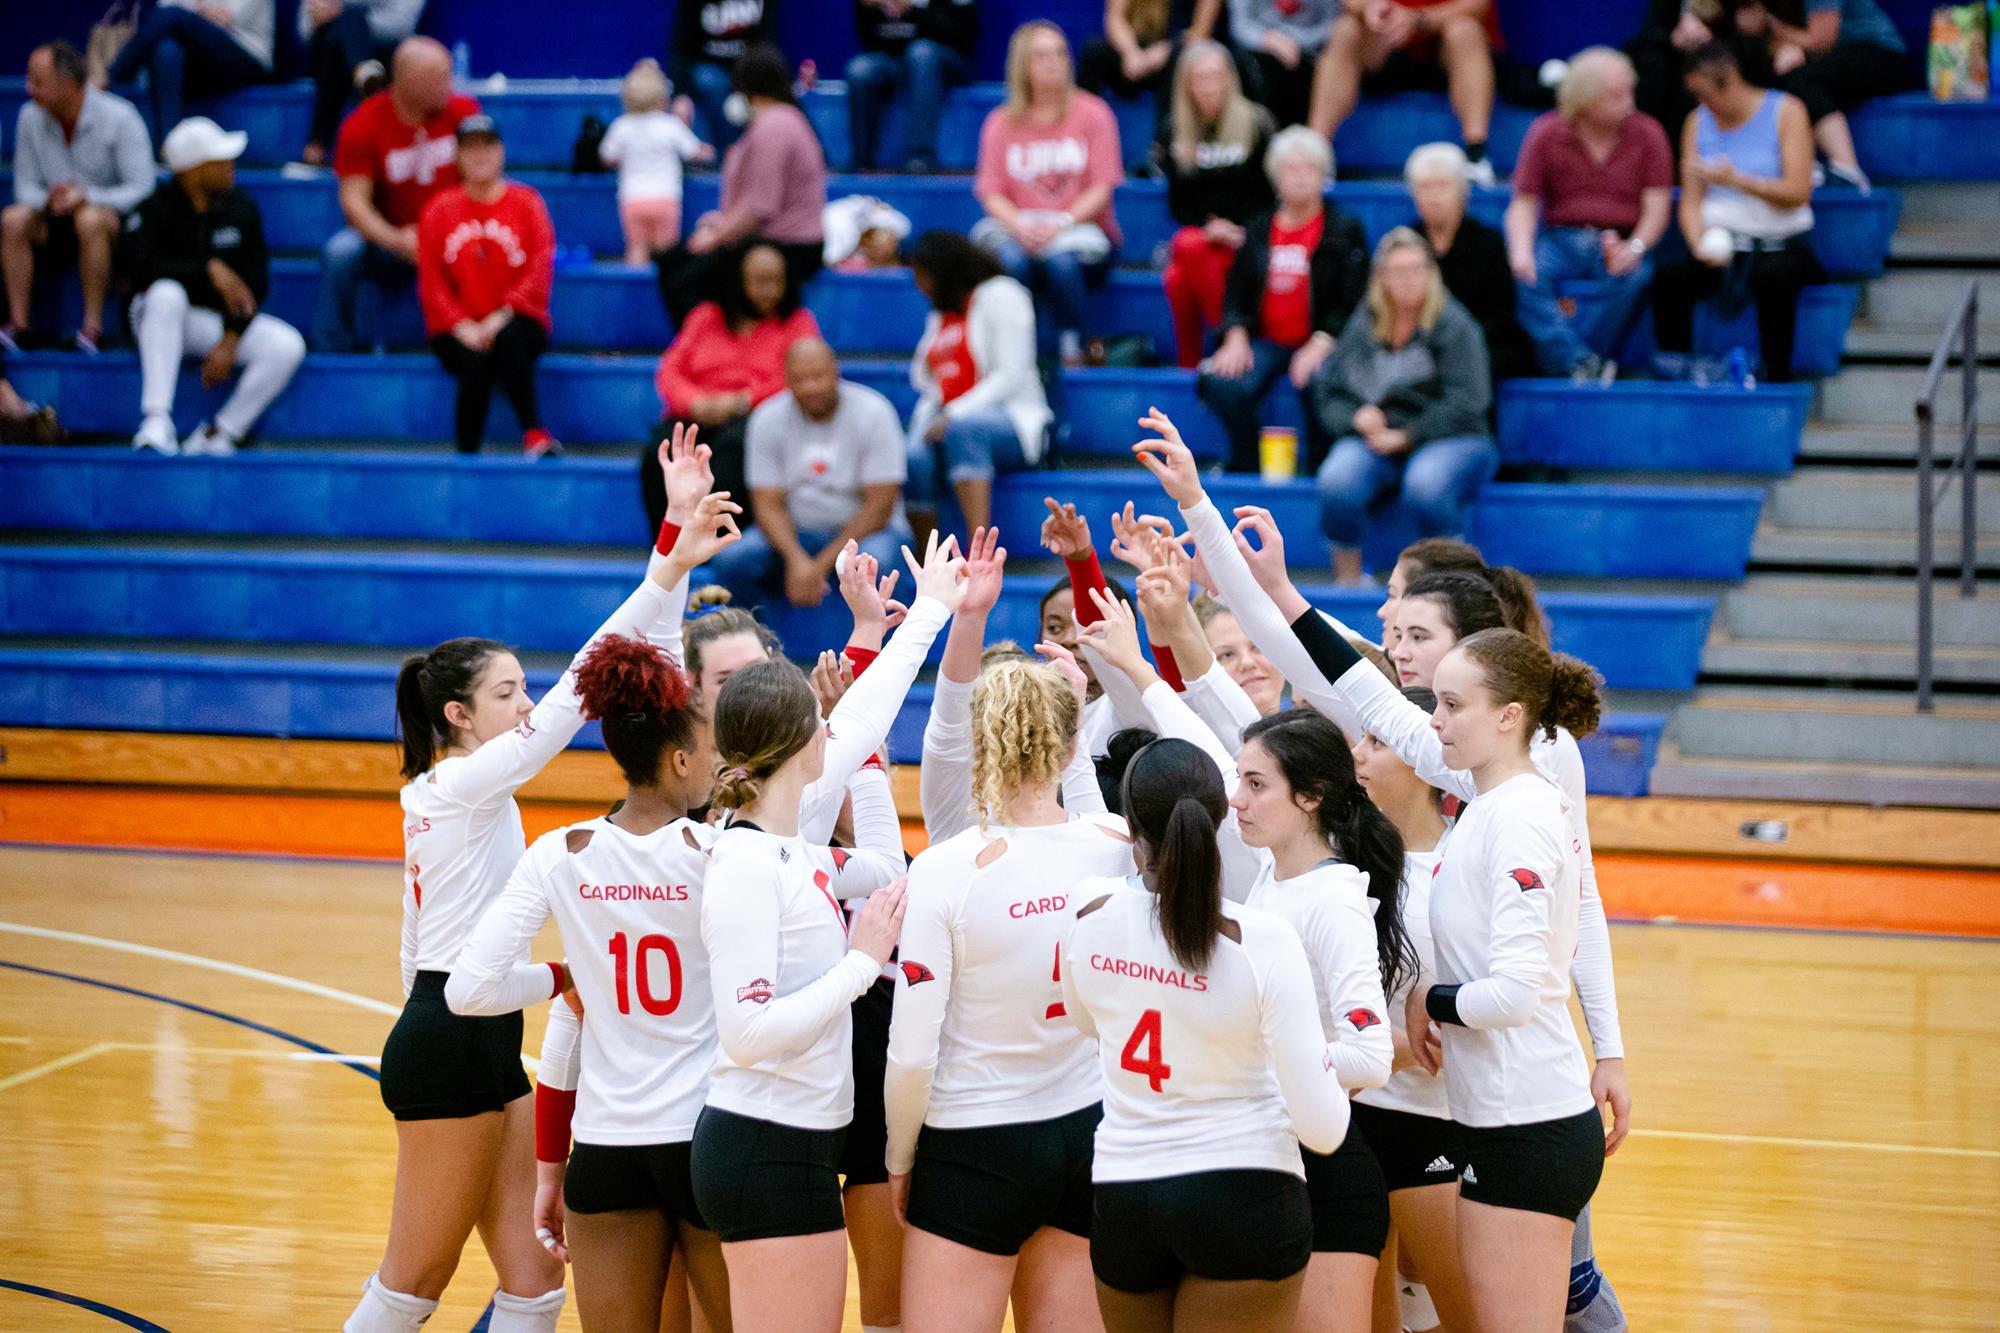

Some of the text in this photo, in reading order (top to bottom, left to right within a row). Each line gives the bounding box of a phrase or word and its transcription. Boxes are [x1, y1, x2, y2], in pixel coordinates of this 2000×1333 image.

[579, 883, 689, 900] CARDINALS
[1009, 894, 1069, 919] CARD
[608, 931, 683, 1016] 10
[1090, 953, 1209, 992] CARDINALS
[1121, 1008, 1171, 1093] 4
